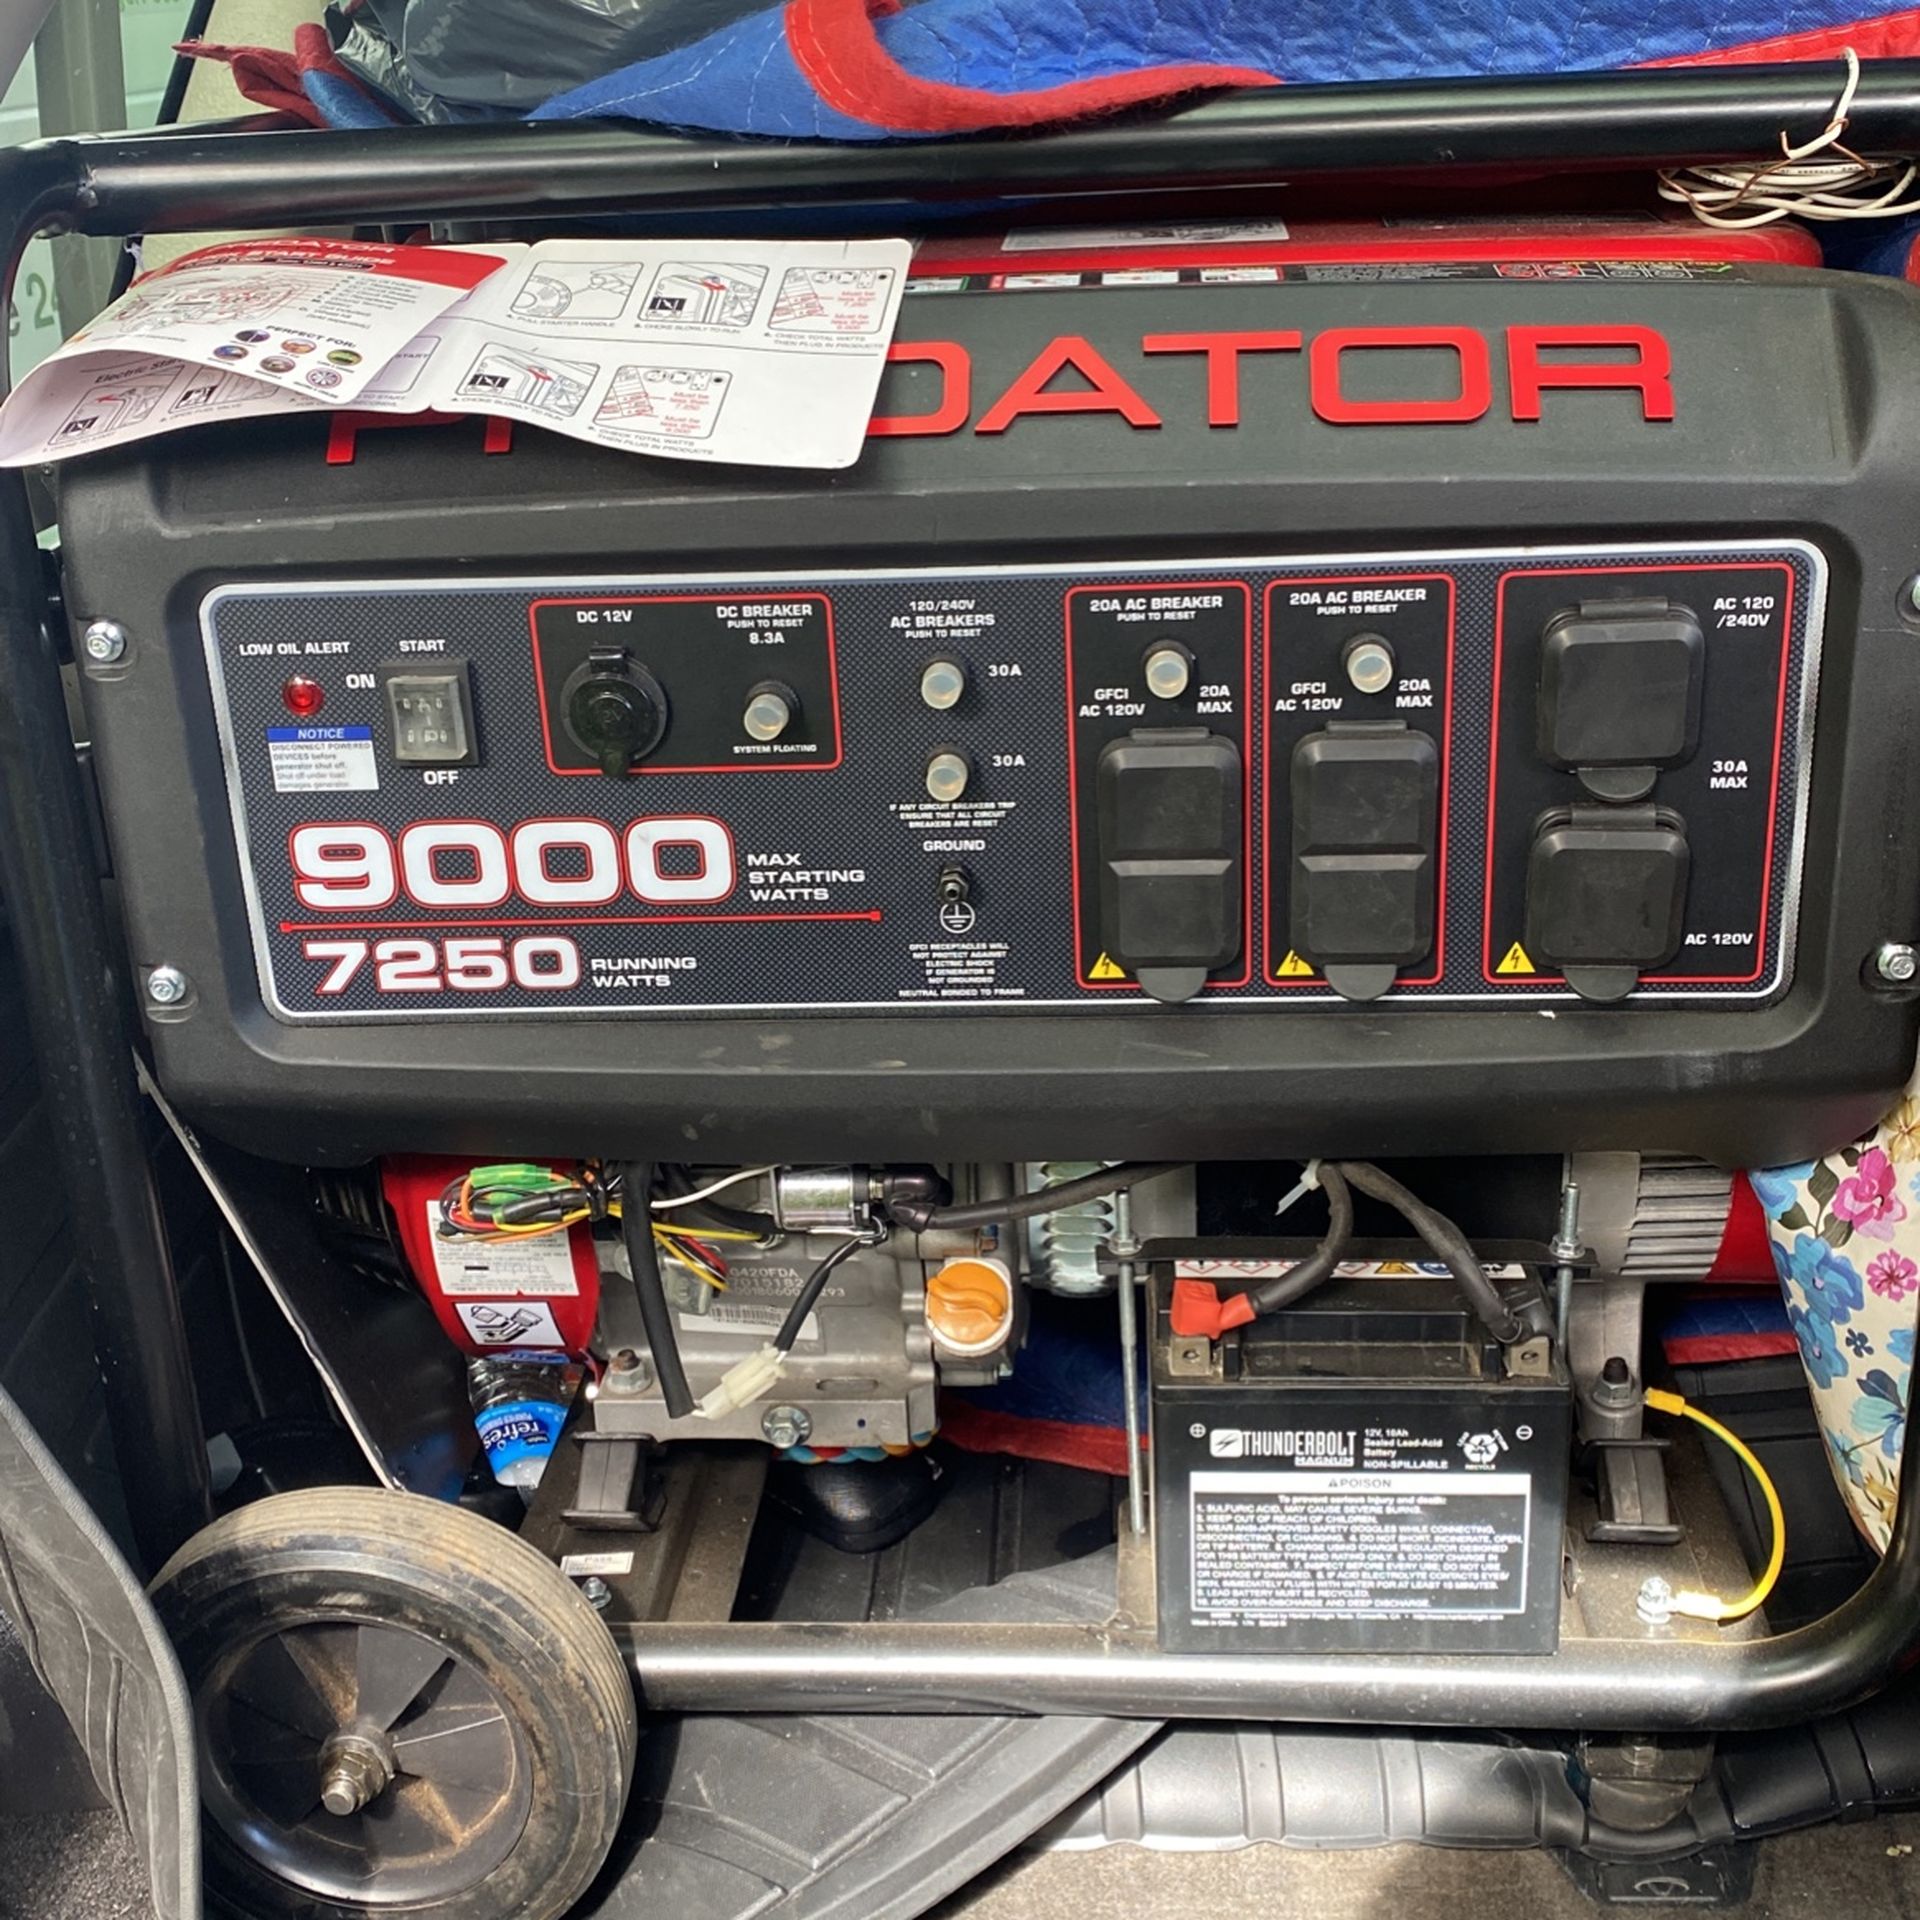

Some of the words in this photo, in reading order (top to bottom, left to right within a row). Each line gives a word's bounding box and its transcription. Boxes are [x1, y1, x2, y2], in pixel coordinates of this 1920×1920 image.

[326, 254, 396, 265] GUIDE
[266, 325, 324, 341] PERFECT
[326, 336, 357, 348] FOR:
[95, 365, 148, 384] Electric
[1290, 592, 1320, 606] 20A
[1325, 591, 1348, 604] AC
[1350, 588, 1426, 603] BREAKER
[1713, 597, 1738, 610] AC
[1742, 596, 1774, 610] 120
[909, 600, 976, 612] 120/240V
[1090, 599, 1120, 612] 20A
[1126, 598, 1148, 611] AC
[1150, 596, 1223, 610] BREAKER
[1316, 606, 1346, 616] PUSH
[1348, 605, 1362, 614] TO
[1364, 604, 1398, 614] RESET
[576, 610, 600, 623] DC
[602, 610, 633, 622] 12V
[716, 606, 739, 618] DC
[742, 604, 812, 618] BREAKER
[1117, 612, 1145, 622] PUSH
[1148, 612, 1161, 621] TO
[1164, 611, 1196, 620] RESET
[728, 620, 754, 628] PUSH
[756, 619, 770, 628] TO
[772, 618, 804, 628] RESET
[890, 616, 912, 628] AC
[915, 614, 996, 628] BREAKERS
[1716, 614, 1770, 628] /240V
[749, 632, 785, 644] 8.3A
[905, 629, 932, 638] PUSH
[935, 629, 948, 638] TO
[950, 628, 982, 638] RESET
[240, 643, 273, 656] LOW
[277, 642, 302, 656] OIL
[304, 641, 350, 654] ALERT
[399, 639, 446, 652] START
[988, 664, 1022, 677] 30A
[346, 674, 376, 689] ON
[1399, 678, 1431, 692] 20A
[1094, 688, 1129, 700] GFCI
[1199, 684, 1230, 698] 20A
[1290, 682, 1326, 695] GFCI
[1197, 701, 1232, 714] MAX
[1274, 699, 1297, 712] AC
[1301, 698, 1342, 711] 120V
[1396, 695, 1433, 708] MAX
[1079, 704, 1100, 718] AC
[1105, 704, 1146, 716] 120V
[298, 728, 345, 740] NOTICE
[272, 743, 326, 752] DISCONNECT
[328, 742, 371, 750] POWERED
[733, 746, 772, 754] SYSTEM
[773, 744, 817, 753] FLOATING
[274, 752, 310, 760] DEVICES
[311, 752, 336, 760] before
[992, 754, 1026, 767] 30A
[276, 763, 313, 772] generator
[1712, 760, 1748, 773] 30A
[423, 770, 459, 785] OFF
[1710, 776, 1748, 790] MAX
[952, 802, 996, 810] BREAKERS
[998, 802, 1016, 810] TRIP
[900, 812, 934, 820] ENSURE
[936, 811, 955, 820] THAT
[957, 811, 972, 819] ALL
[974, 810, 1006, 819] CIRCUIT
[908, 820, 952, 829] BREAKERS
[954, 820, 970, 828] ARE
[972, 819, 998, 828] RESET
[922, 840, 986, 852] GROUND
[290, 814, 736, 912] 9000
[747, 852, 802, 866] MAX
[749, 869, 866, 884] STARTING
[749, 886, 830, 902] WATTS
[1685, 932, 1710, 946] AC
[1714, 932, 1754, 945] 120V
[302, 934, 581, 997] 7250
[590, 956, 698, 972] RUNNING
[592, 974, 672, 989] WATTS
[898, 989, 940, 998] NEUTRAL
[1364, 1428, 1384, 1439] 12V,
[1242, 1430, 1358, 1456] THUNDERBOLT
[1364, 1438, 1395, 1448] Sealed
[1397, 1438, 1443, 1448] Lead-Acid
[1364, 1448, 1397, 1458] Battery
[1295, 1457, 1354, 1467] MAGNUM
[1363, 1460, 1448, 1470] NON-SPILLABLE
[1340, 1478, 1392, 1488] POISON
[1206, 1504, 1254, 1514] SULFURIC
[1284, 1505, 1306, 1514] MAY
[1308, 1505, 1342, 1514] CAUSE
[1344, 1506, 1384, 1514] SEVERE
